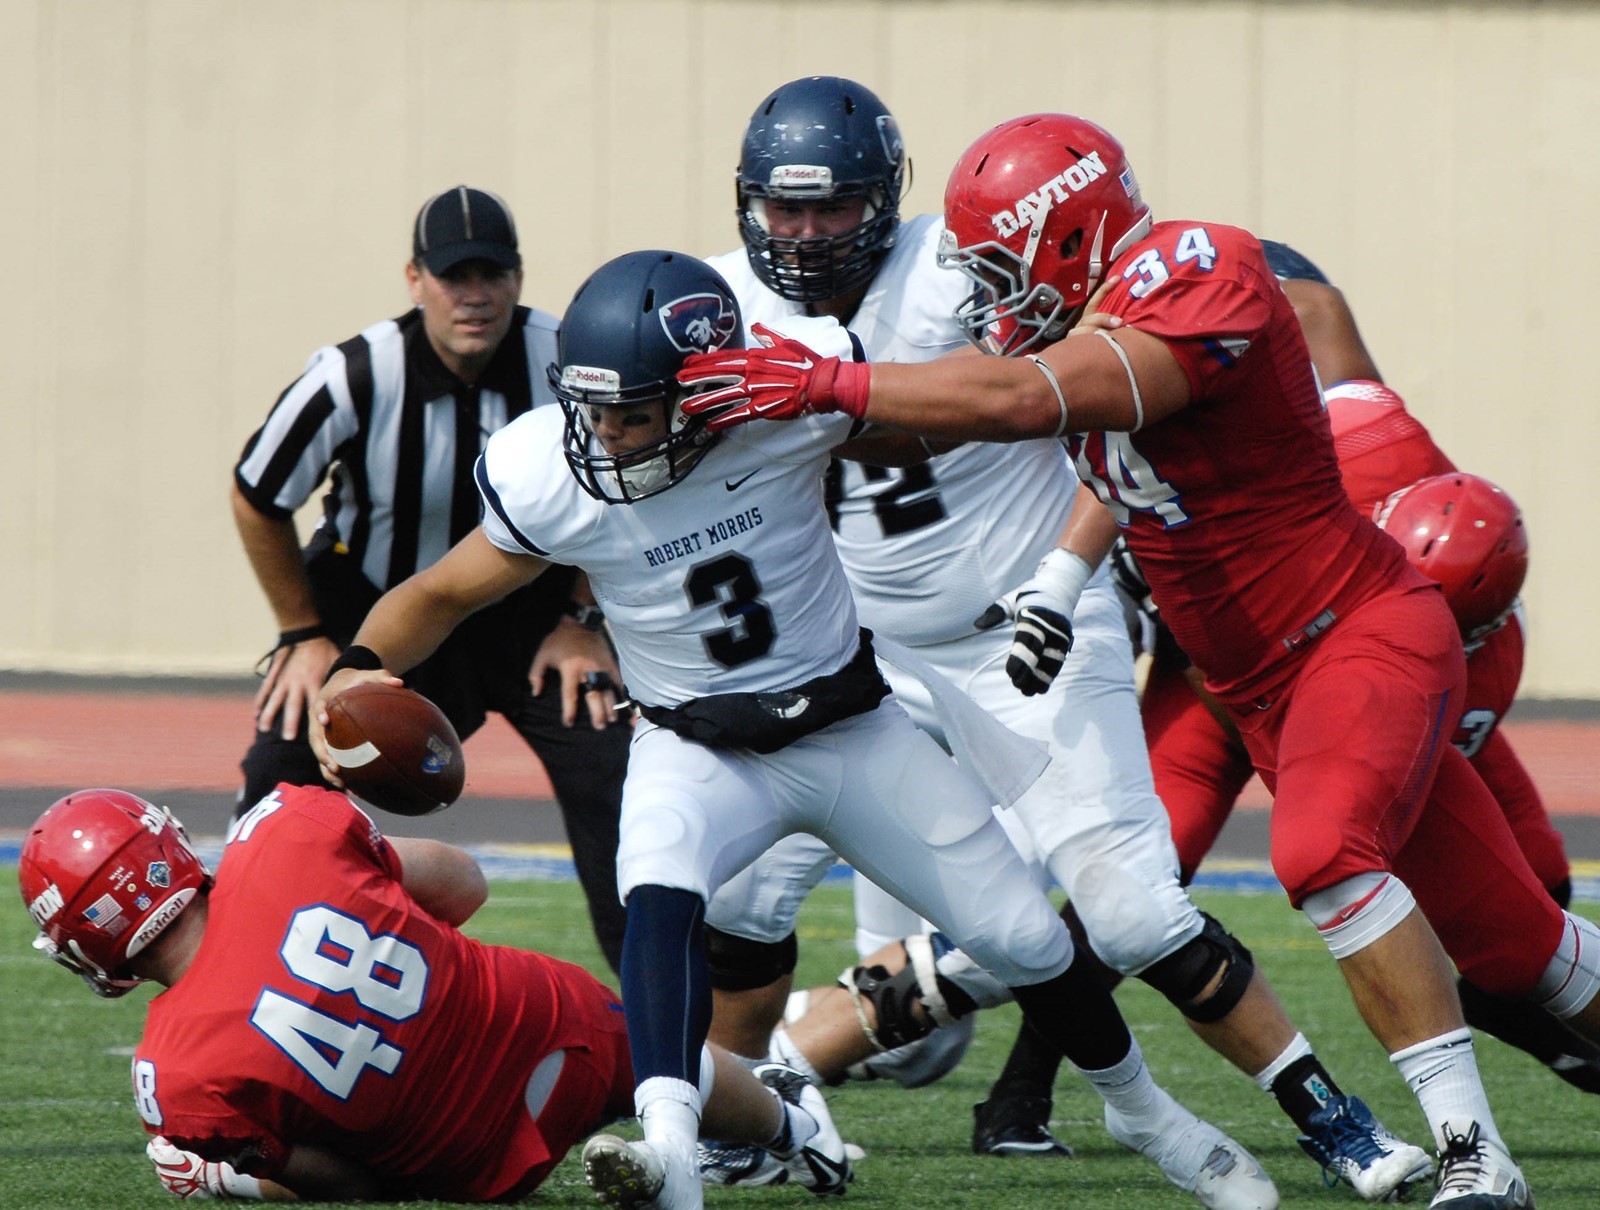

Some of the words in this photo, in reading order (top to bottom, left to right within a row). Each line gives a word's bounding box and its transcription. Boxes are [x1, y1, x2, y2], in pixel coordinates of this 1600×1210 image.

[992, 151, 1108, 239] DAYTON
[1121, 226, 1218, 300] 34
[575, 370, 606, 383] Riddell
[644, 532, 703, 568] ROBERT
[705, 506, 764, 546] MORRIS
[682, 549, 779, 672] 3
[138, 896, 185, 943] Riddell
[247, 902, 431, 1104] 48
